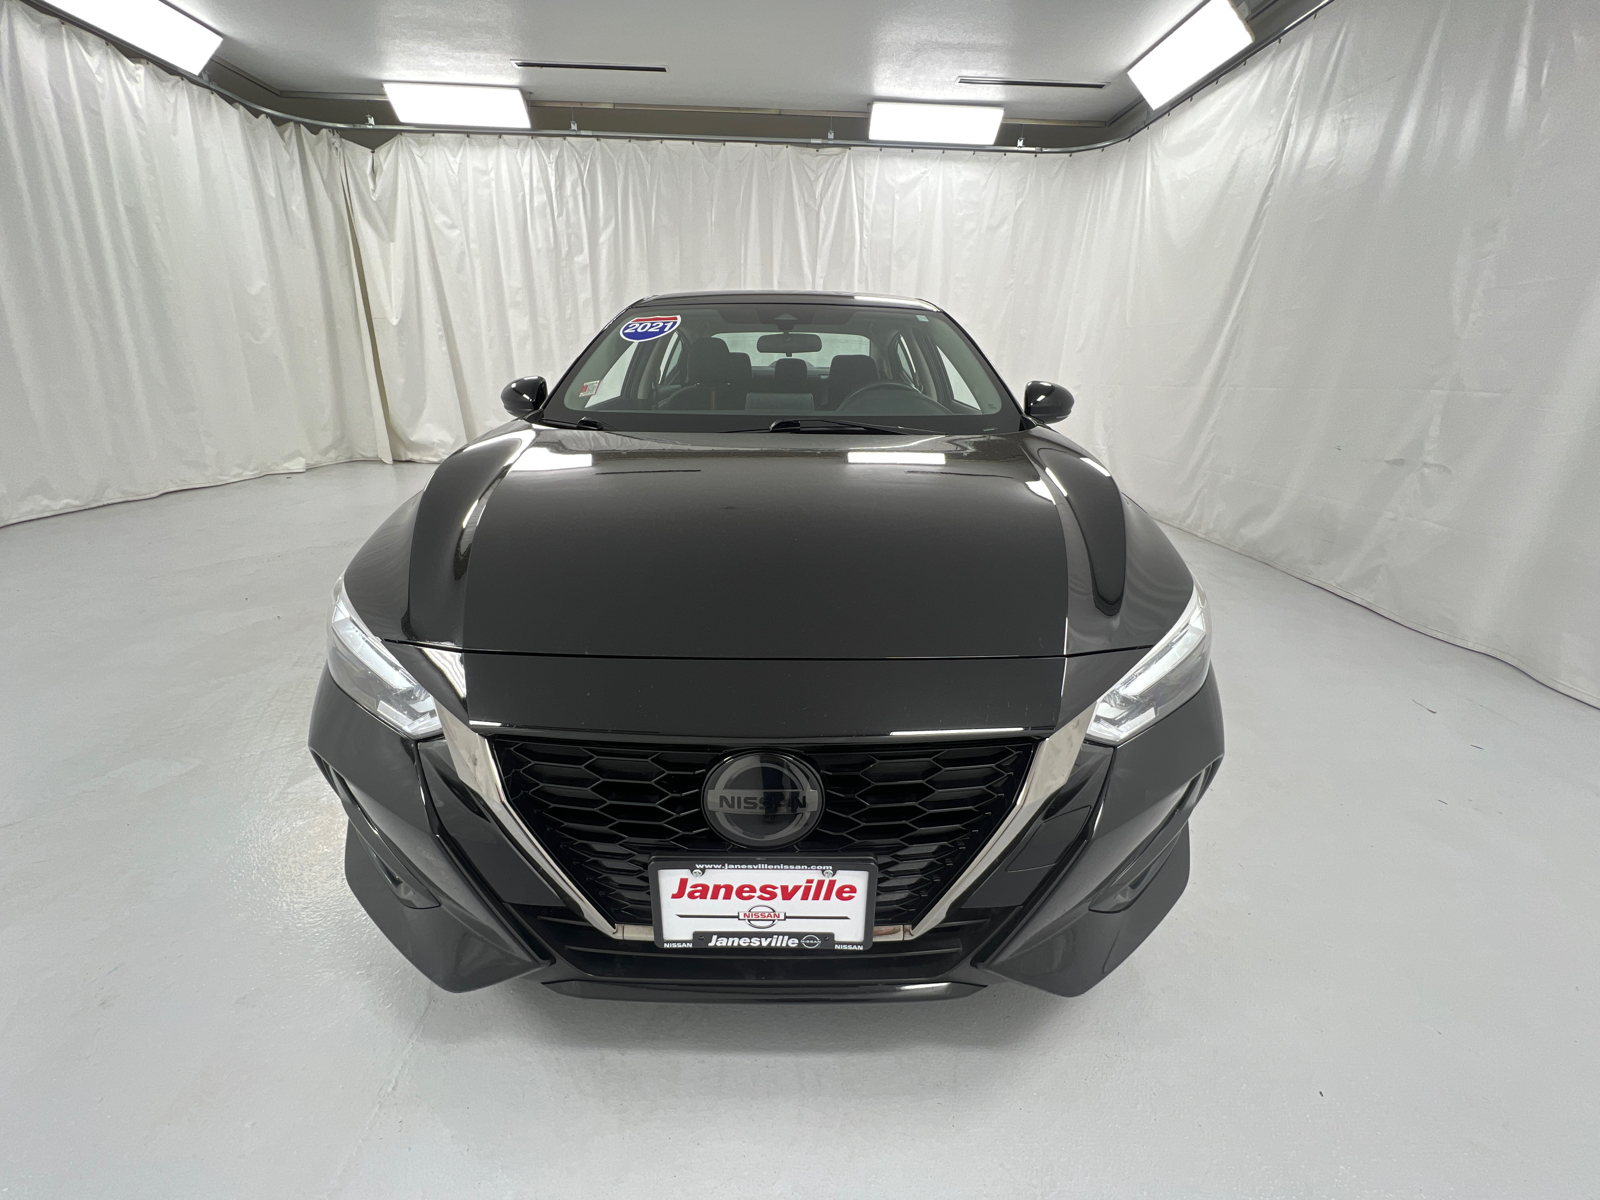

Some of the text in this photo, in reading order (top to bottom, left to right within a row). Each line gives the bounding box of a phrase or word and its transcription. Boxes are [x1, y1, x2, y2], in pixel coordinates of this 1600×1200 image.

[622, 321, 675, 333] 2021
[670, 877, 858, 902] Janesville
[707, 934, 799, 948] Janesville
